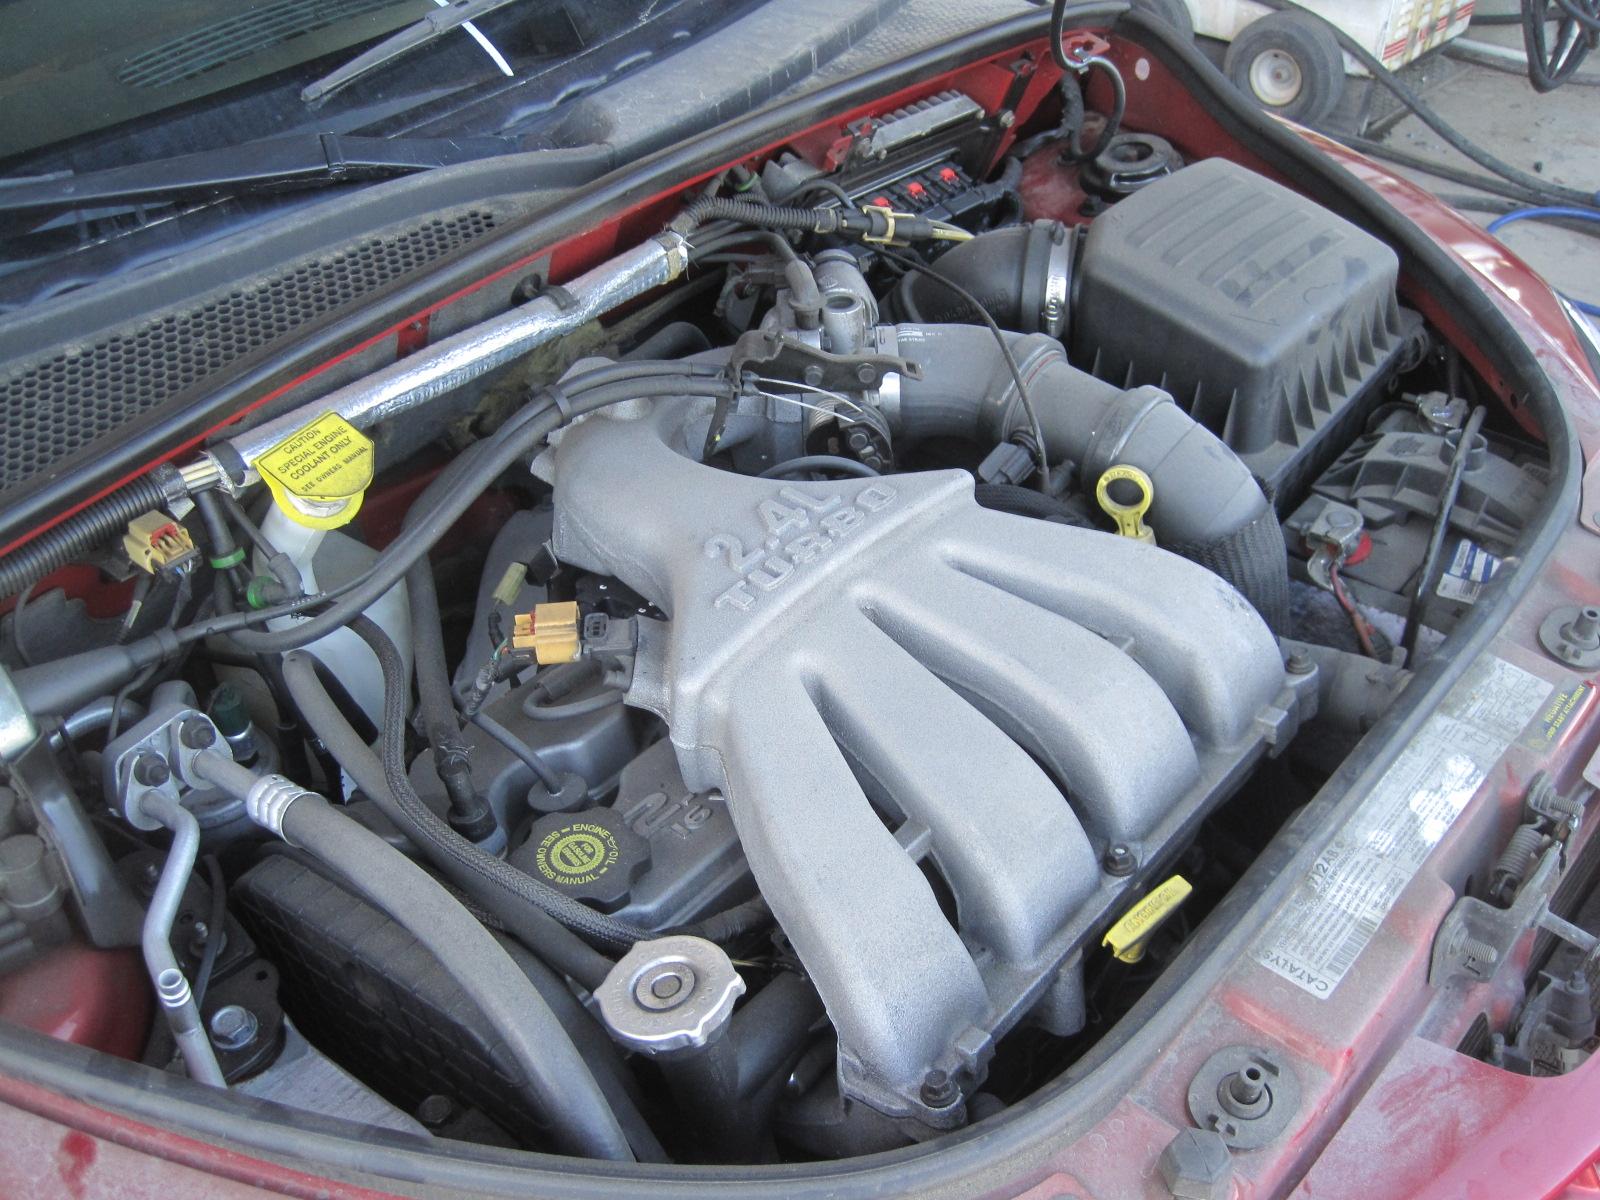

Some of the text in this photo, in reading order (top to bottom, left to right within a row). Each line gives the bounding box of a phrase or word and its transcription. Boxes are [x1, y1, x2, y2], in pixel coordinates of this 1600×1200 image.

[278, 426, 348, 474] SPECIAL ENGINE
[283, 428, 321, 454] CAUTION
[290, 436, 352, 480] COOLANT ONLY
[301, 481, 316, 491] SEE
[343, 446, 368, 464] MANUAL
[703, 486, 842, 573] 2.4L
[713, 484, 898, 611] TURBO
[536, 831, 600, 885] SEE OWNERS MANUAL
[572, 824, 619, 865] ENGINE OIL
[1257, 949, 1329, 992] CATALYS
